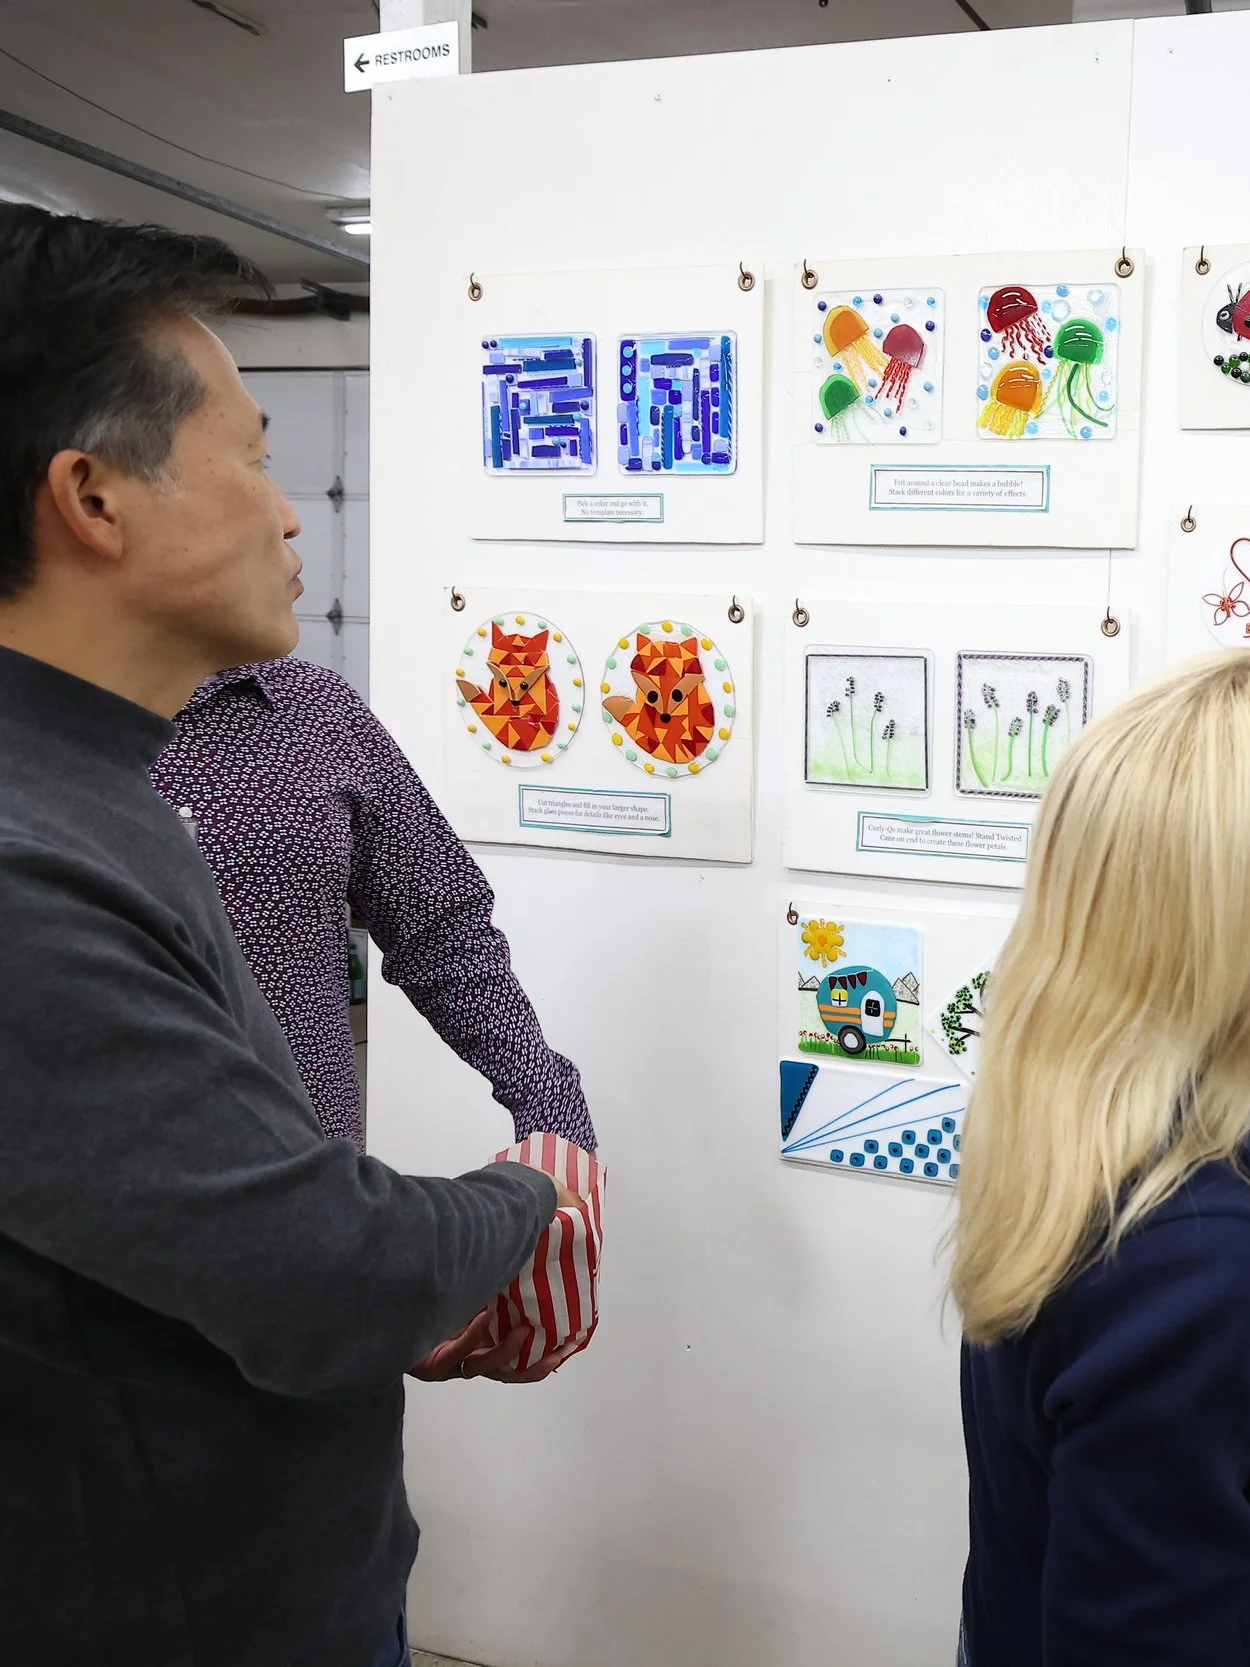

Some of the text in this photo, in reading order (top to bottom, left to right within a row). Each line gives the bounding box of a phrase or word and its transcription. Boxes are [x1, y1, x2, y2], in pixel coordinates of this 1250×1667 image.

[375, 43, 450, 67] RESTROOMS
[907, 479, 930, 487] around
[936, 479, 952, 487] clear
[970, 480, 991, 488] makes
[997, 480, 1023, 488] bubble!
[888, 488, 905, 496] Stack
[907, 488, 934, 496] different
[935, 489, 955, 497] colors
[956, 488, 966, 497] for
[972, 489, 994, 498] variety
[995, 489, 1004, 497] of
[1004, 489, 1027, 497] effects.
[528, 806, 543, 814] Stack
[584, 810, 602, 818] details
[614, 813, 627, 821] eyes
[548, 800, 572, 808] triangles
[612, 804, 629, 812] larger
[630, 805, 649, 813] shape.
[868, 825, 895, 834] Curly-Qs
[915, 828, 931, 836] great
[932, 829, 952, 837] flower
[953, 831, 974, 839] stems!
[975, 832, 995, 840] Stand
[996, 833, 1022, 842] Twisted
[906, 835, 918, 843] end
[947, 839, 964, 847] these
[965, 840, 985, 848] flower
[987, 841, 1007, 850] petals.
